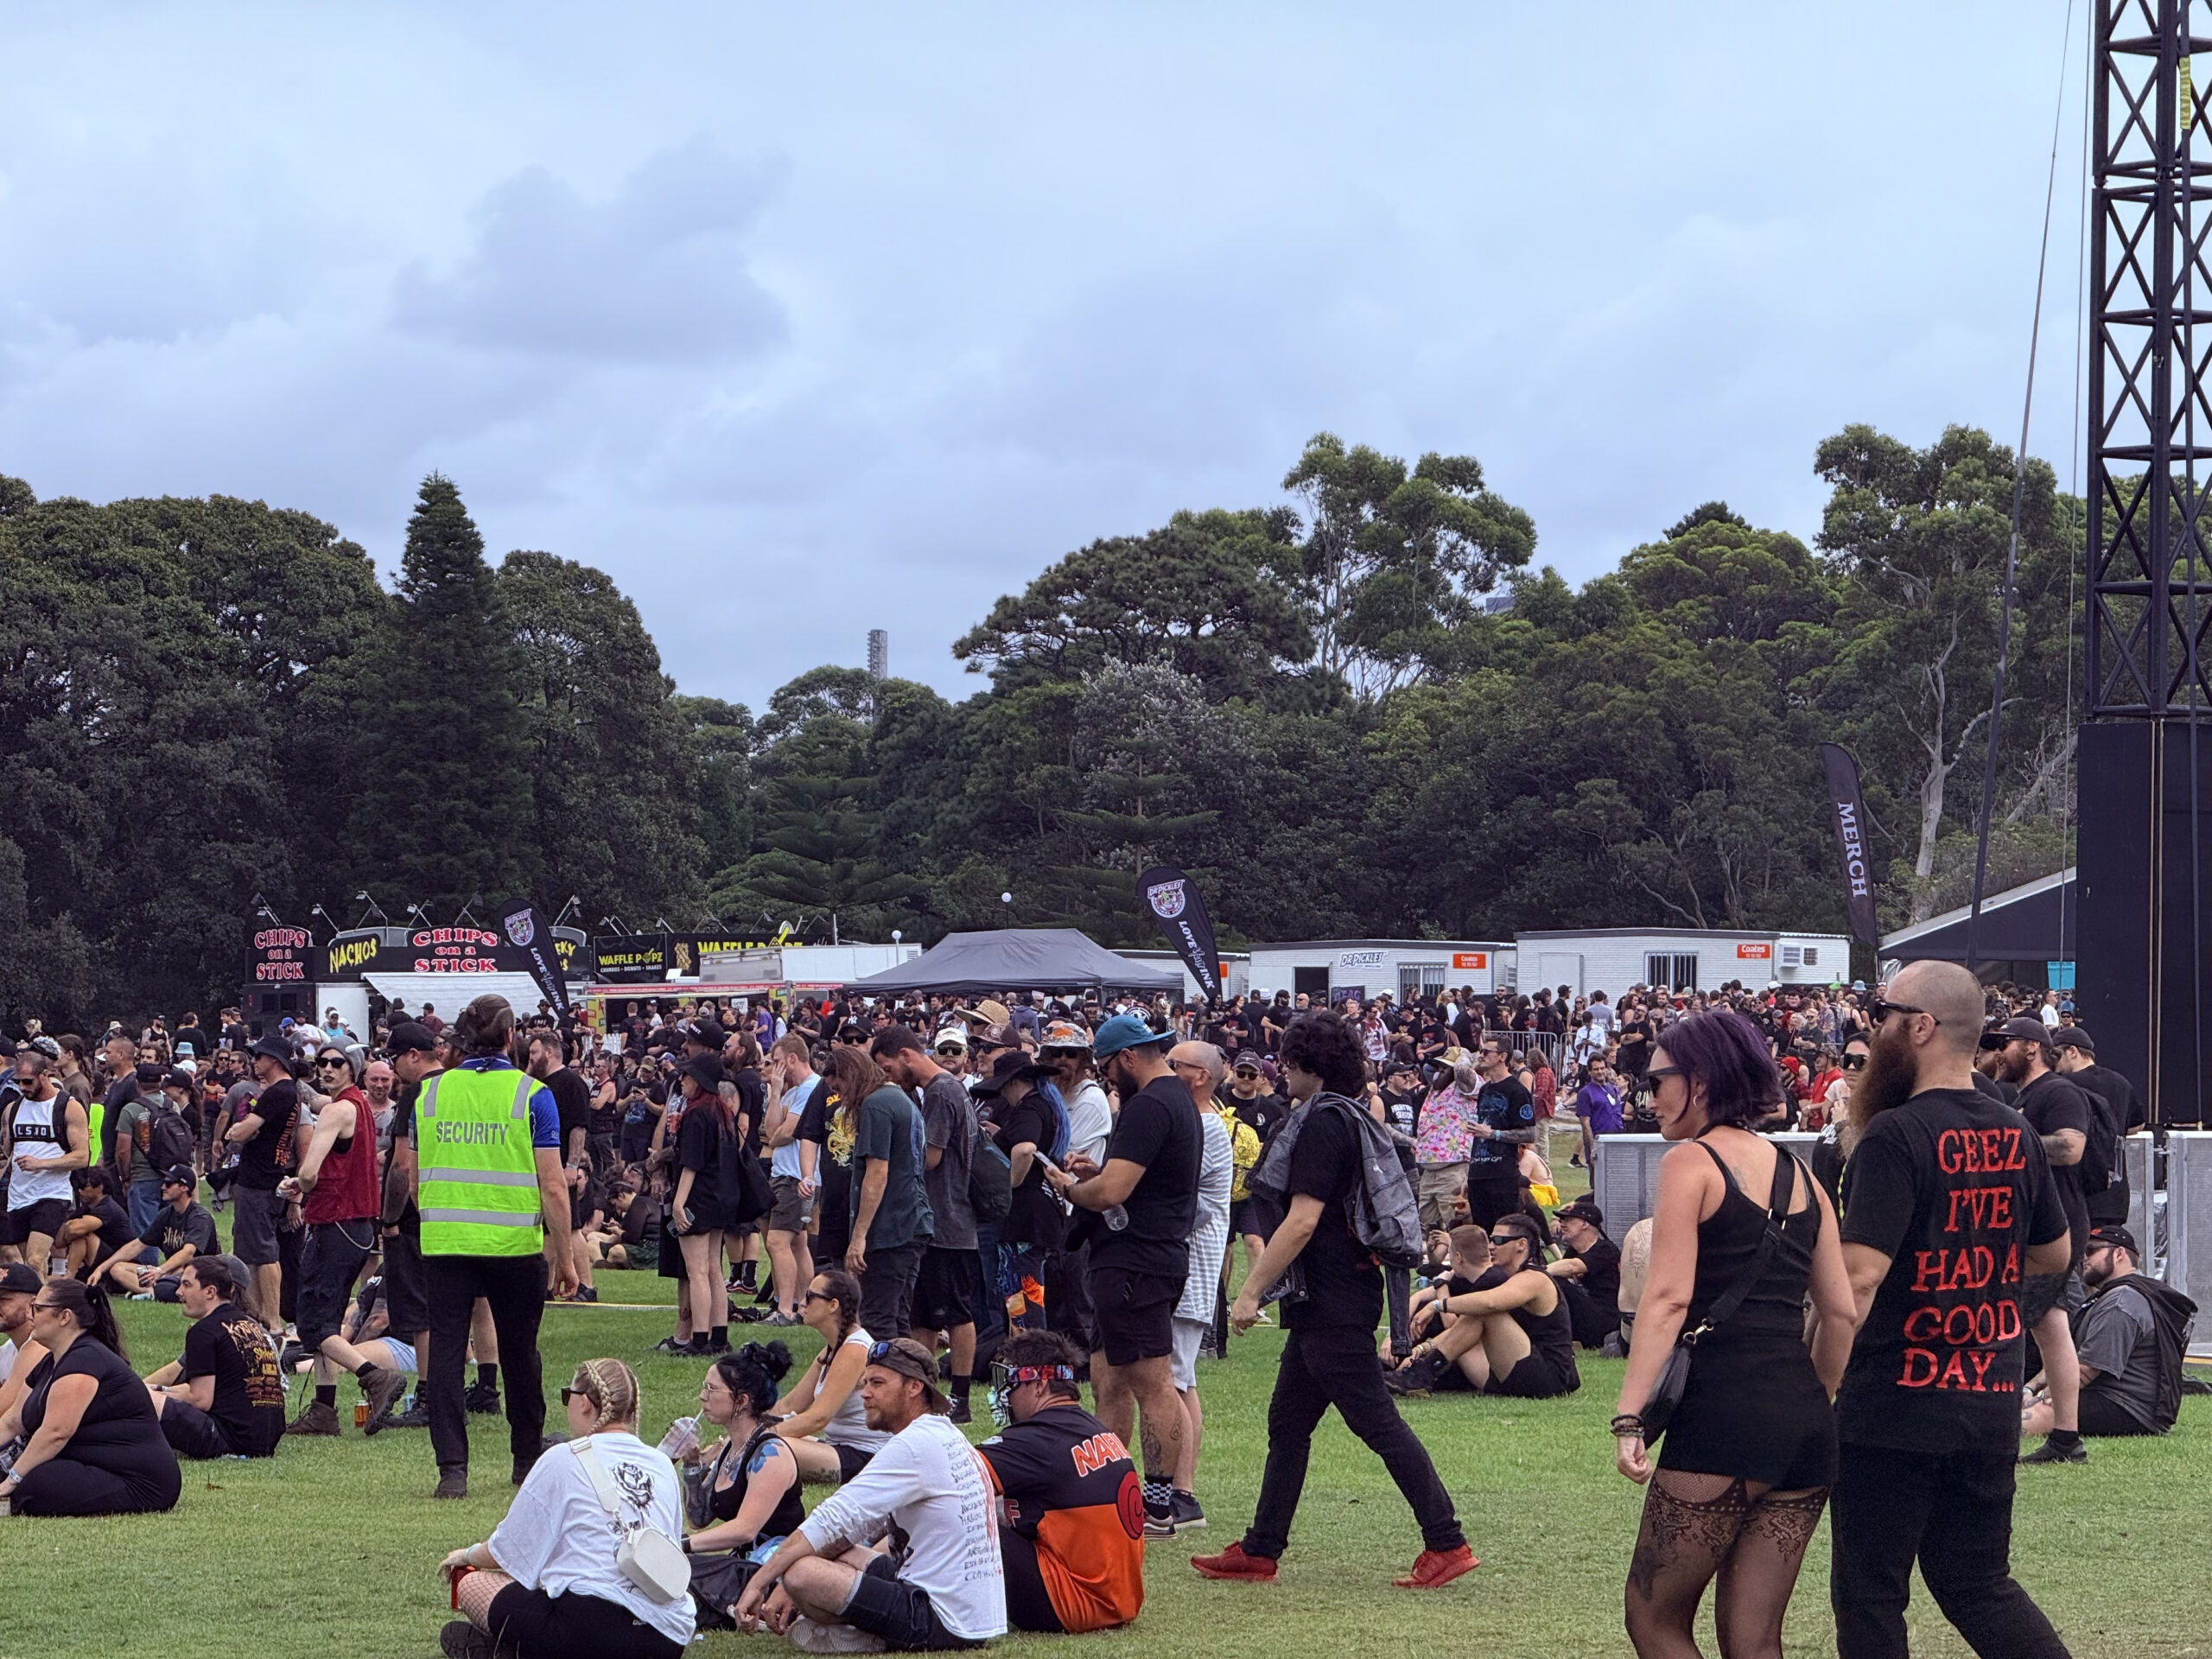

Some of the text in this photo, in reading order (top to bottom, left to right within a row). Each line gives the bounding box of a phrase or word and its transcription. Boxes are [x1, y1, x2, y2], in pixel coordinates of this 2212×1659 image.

[1838, 802, 1868, 899] MERCH
[254, 929, 306, 949] CHIPS
[413, 928, 498, 947] CHIPS
[1741, 944, 1765, 953] Coates
[268, 949, 292, 959] on a
[329, 938, 377, 974] NACHOS
[435, 946, 476, 956] on a
[598, 954, 633, 965] WAFFLE
[1179, 920, 1197, 949] LOVE
[1200, 968, 1215, 988] INK
[1340, 952, 1383, 967] DR PICKLES
[256, 962, 304, 980] STICK
[414, 958, 498, 972] STICK
[531, 947, 547, 972] LOVE
[553, 990, 564, 1011] INK
[435, 1121, 509, 1146] SECURITY
[1937, 1127, 2026, 1174] GEEZ
[1944, 1186, 2012, 1232] I'VE
[1910, 1243, 2018, 1292] HAD A
[1904, 1300, 2022, 1344] GOOD
[1897, 1347, 2015, 1392] DAY...
